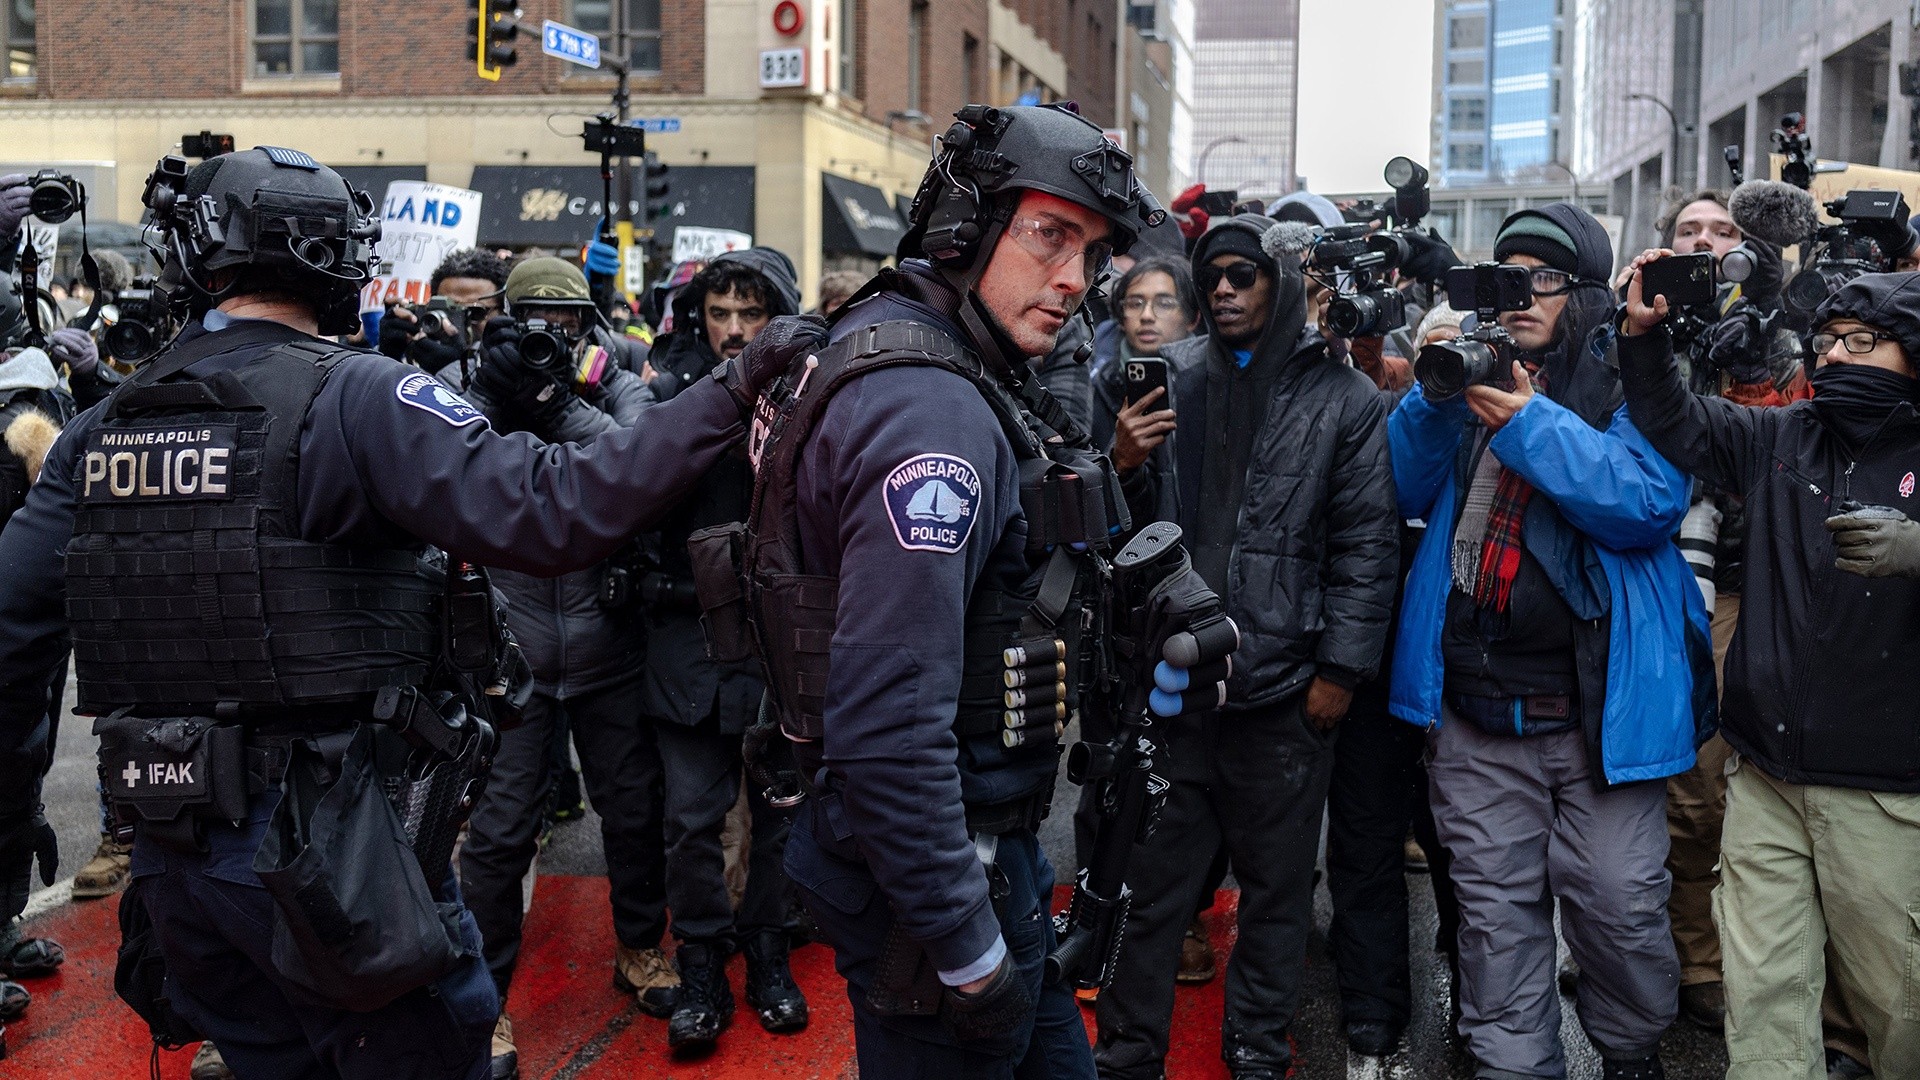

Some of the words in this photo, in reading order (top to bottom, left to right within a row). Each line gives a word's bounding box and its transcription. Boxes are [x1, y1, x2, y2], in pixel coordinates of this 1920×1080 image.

[763, 54, 800, 80] 830
[380, 231, 459, 264] RITY
[101, 429, 212, 446] MINNEAPOLIS
[84, 447, 230, 498] POLICE
[890, 460, 979, 497] MINNEAPOLIS
[910, 526, 958, 545] POLICE
[148, 762, 195, 785] IFAK
